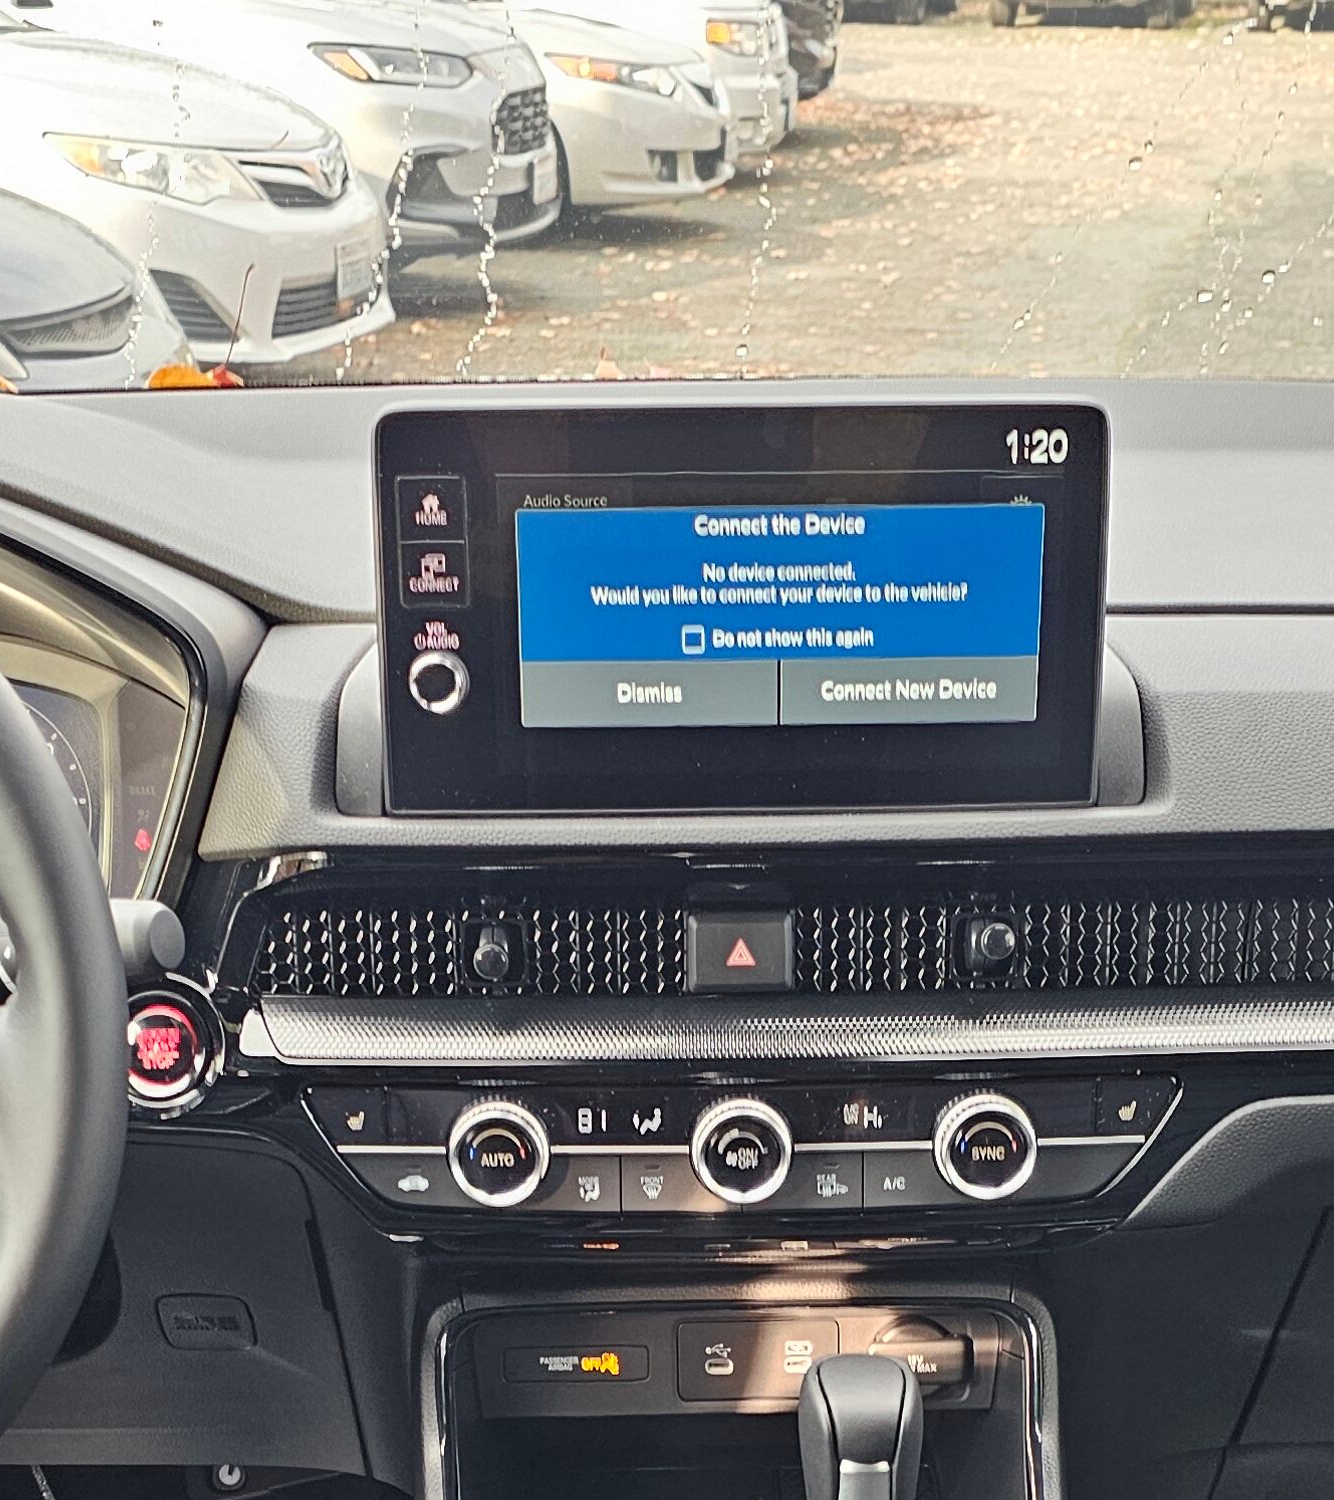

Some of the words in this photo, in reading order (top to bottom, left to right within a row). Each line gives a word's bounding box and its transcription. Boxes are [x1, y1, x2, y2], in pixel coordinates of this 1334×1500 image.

[1006, 430, 1068, 464] 1:20
[524, 495, 561, 507] Audio
[564, 495, 608, 507] Source
[416, 511, 447, 526] HOME
[695, 515, 766, 536] Connect
[772, 514, 800, 535] the
[806, 513, 865, 534] Device
[703, 563, 725, 582] No
[729, 563, 775, 582] device
[777, 561, 855, 581] connected.
[409, 576, 459, 593] CONNECT
[591, 586, 639, 606] Would
[642, 590, 670, 607] you
[672, 585, 697, 604] like
[701, 586, 716, 604] to
[719, 587, 776, 604] connect
[780, 587, 813, 606] your
[816, 584, 862, 603] device
[866, 585, 881, 602] to
[885, 583, 908, 602] the
[911, 582, 968, 602] vehicle?
[425, 622, 448, 634] VOL
[426, 634, 459, 649] AUDIO
[713, 629, 734, 648] Do
[737, 629, 762, 648] not
[765, 628, 804, 647] show
[807, 627, 833, 647] this
[836, 628, 874, 648] again
[617, 683, 682, 703] Dismiss
[821, 680, 891, 702] Connect
[895, 680, 936, 701] New
[939, 678, 997, 700] Device
[480, 1153, 515, 1168] AUTO
[971, 1148, 1005, 1162] SYNC
[883, 1176, 906, 1191] A/C
